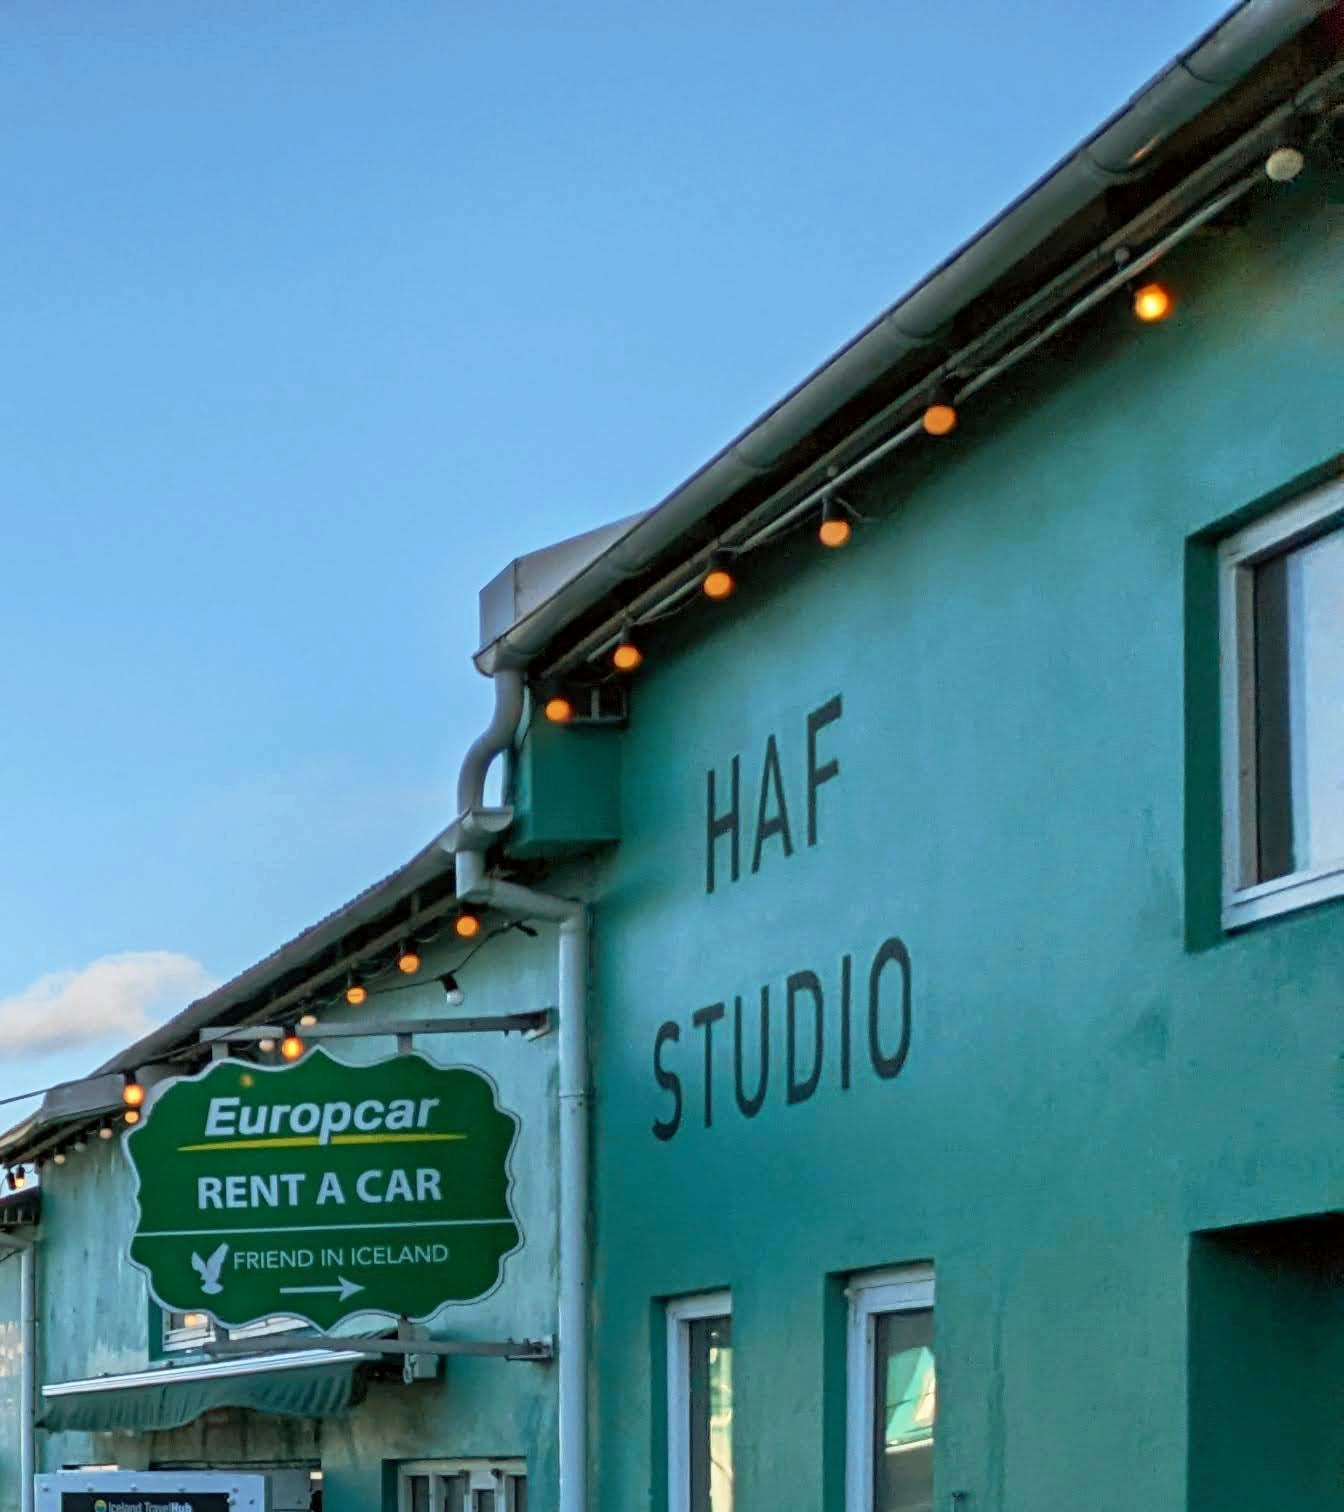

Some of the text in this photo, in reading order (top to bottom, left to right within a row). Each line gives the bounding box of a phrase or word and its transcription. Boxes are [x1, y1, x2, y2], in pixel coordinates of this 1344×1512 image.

[705, 692, 843, 894] HAF
[652, 936, 912, 1142] STUDIO
[204, 1097, 440, 1146] Europcar
[198, 1168, 443, 1210] RENT A CAR
[233, 1244, 450, 1270] FRIEND IN ICELAND
